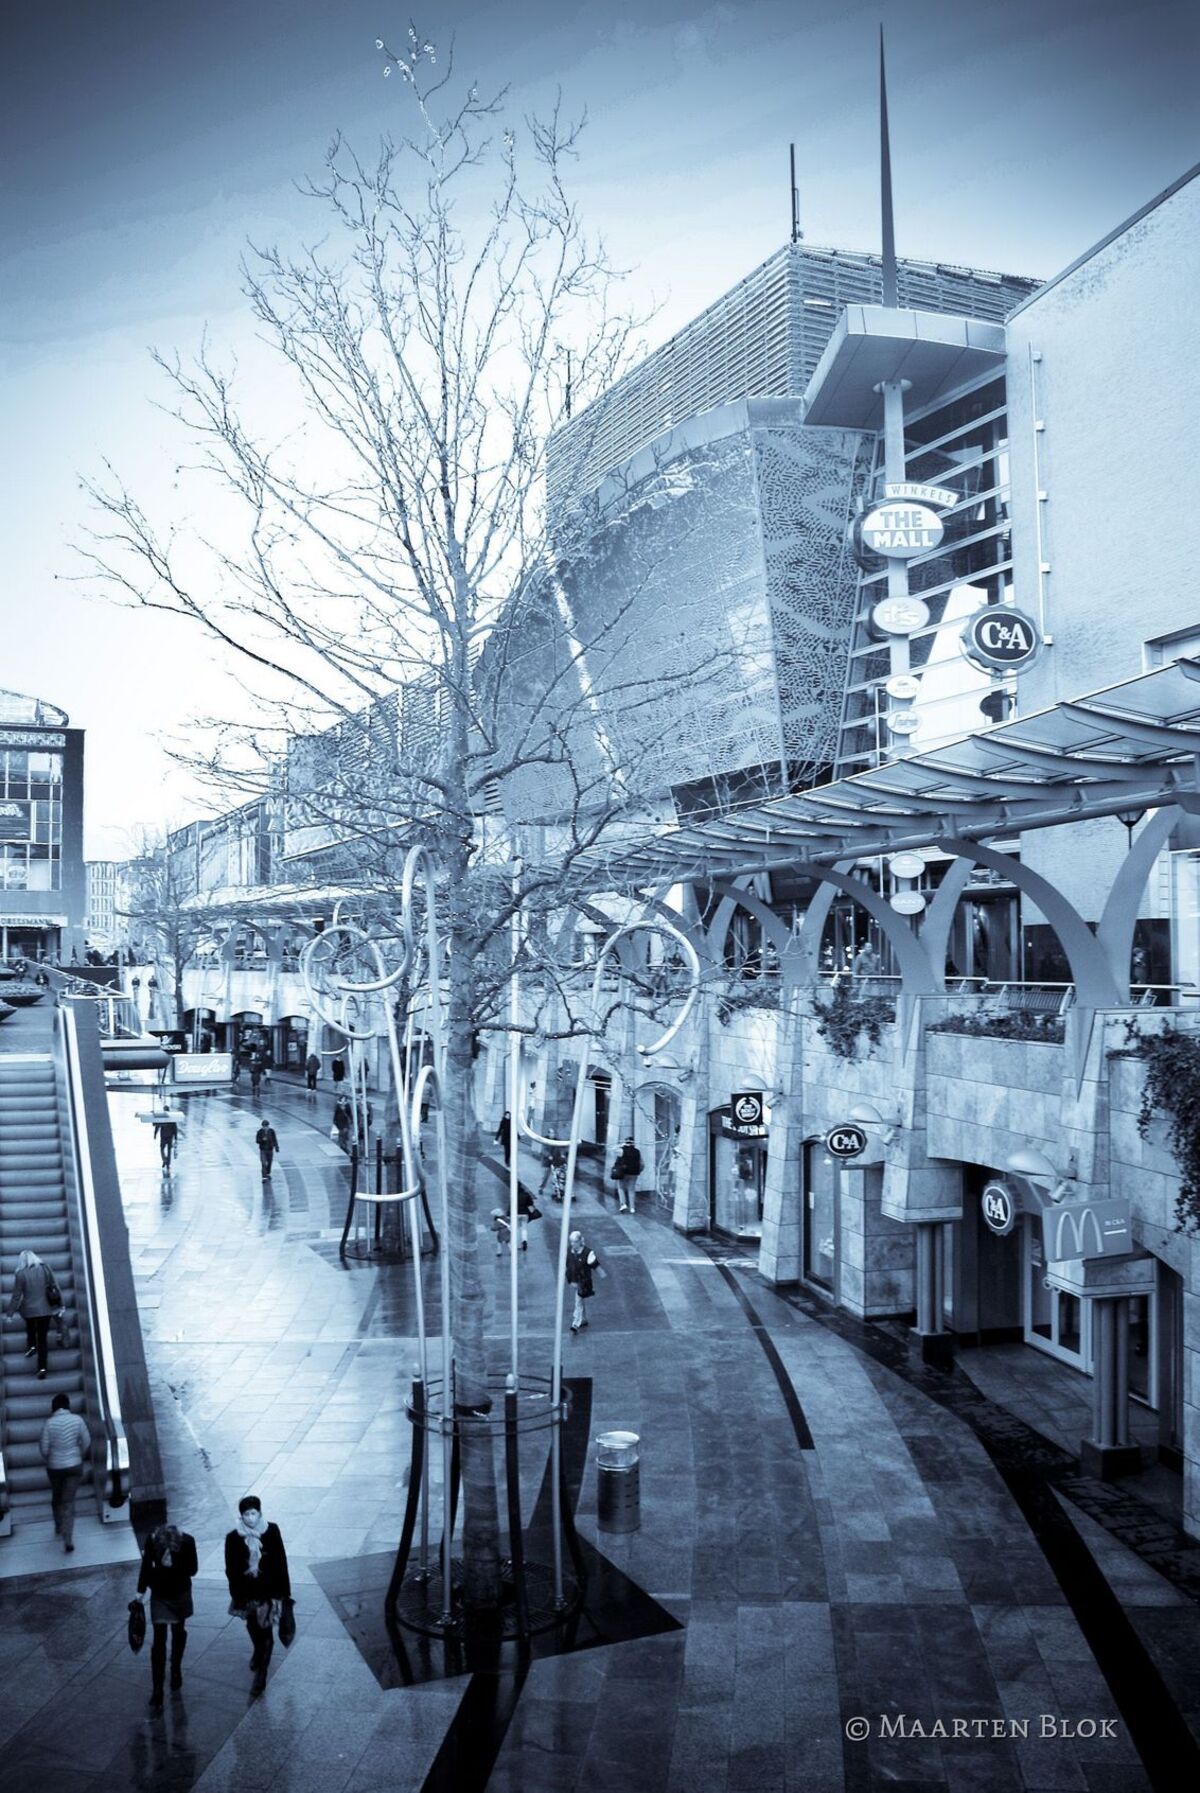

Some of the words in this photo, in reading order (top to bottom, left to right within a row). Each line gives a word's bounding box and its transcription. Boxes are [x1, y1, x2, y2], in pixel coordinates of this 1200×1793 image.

[890, 485, 954, 503] WINKELS
[879, 511, 923, 528] THE
[873, 531, 934, 548] MALL
[981, 621, 1029, 650] C&A
[832, 1134, 860, 1149] C&A
[985, 1194, 1007, 1221] C&A
